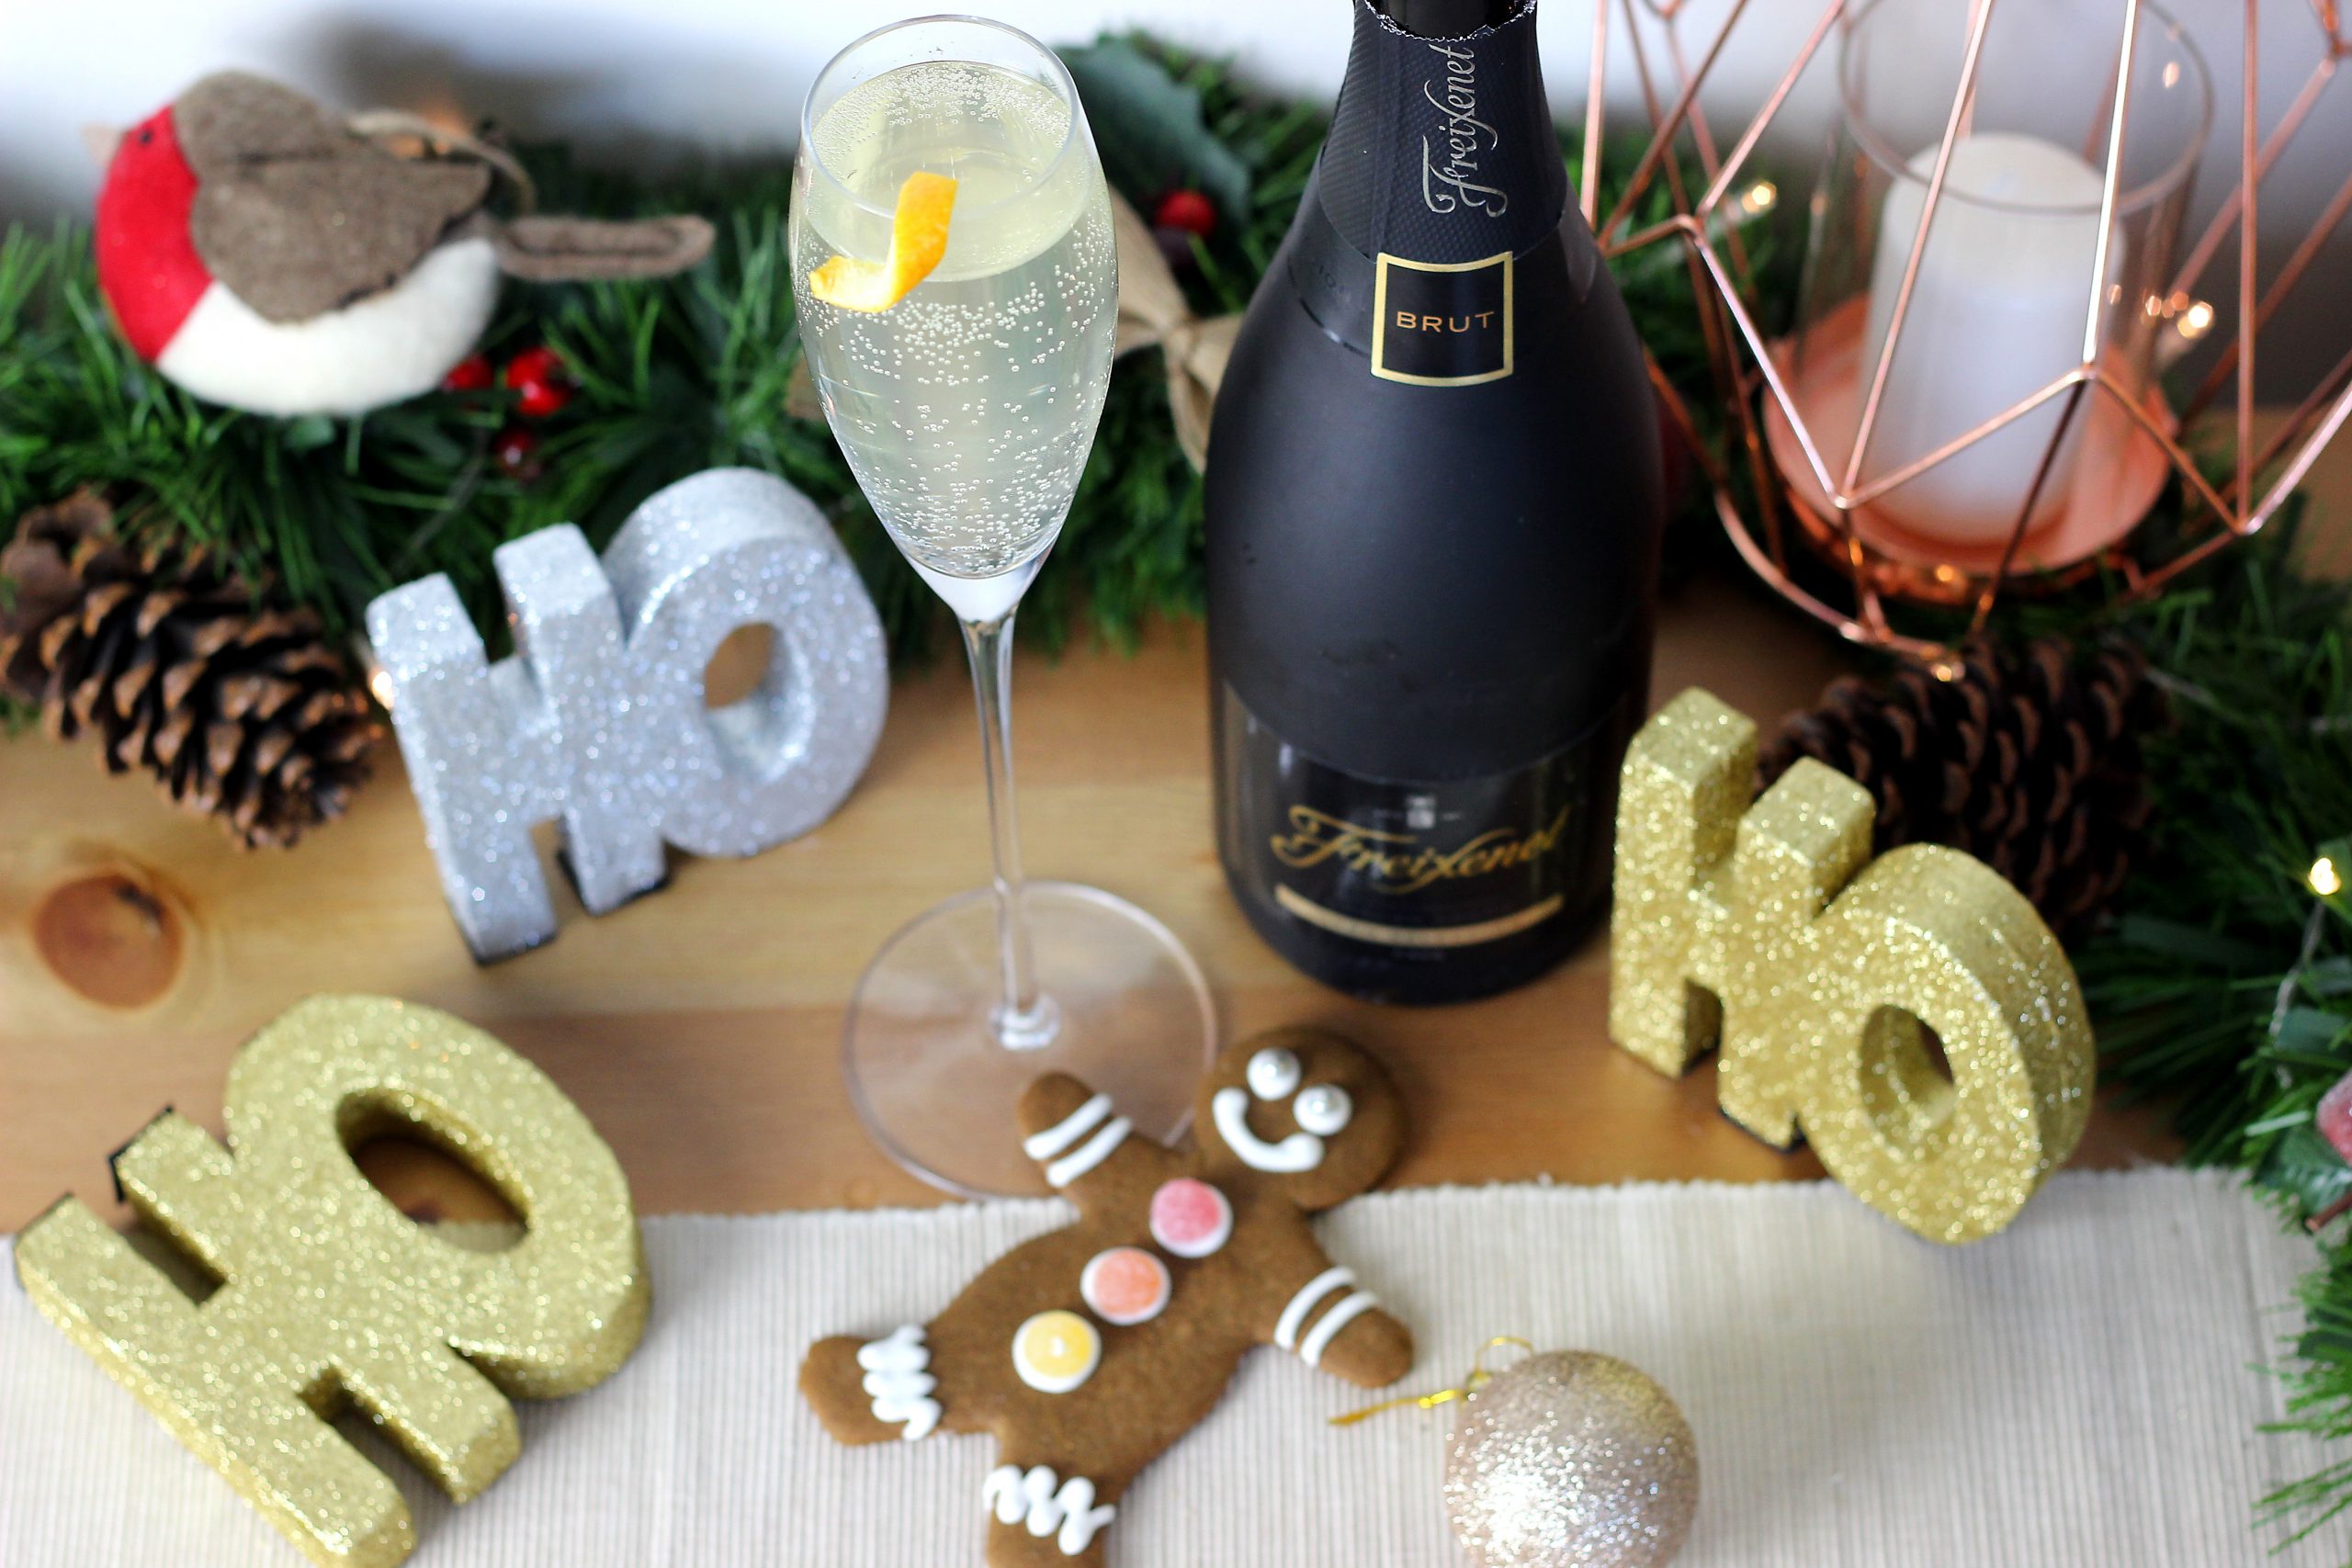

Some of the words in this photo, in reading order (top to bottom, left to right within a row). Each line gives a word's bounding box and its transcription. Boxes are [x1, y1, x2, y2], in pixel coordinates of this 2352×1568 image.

[1422, 43, 1508, 219] Freixenet
[1396, 310, 1495, 333] BRUT
[1270, 805, 1573, 895] Freixenet
